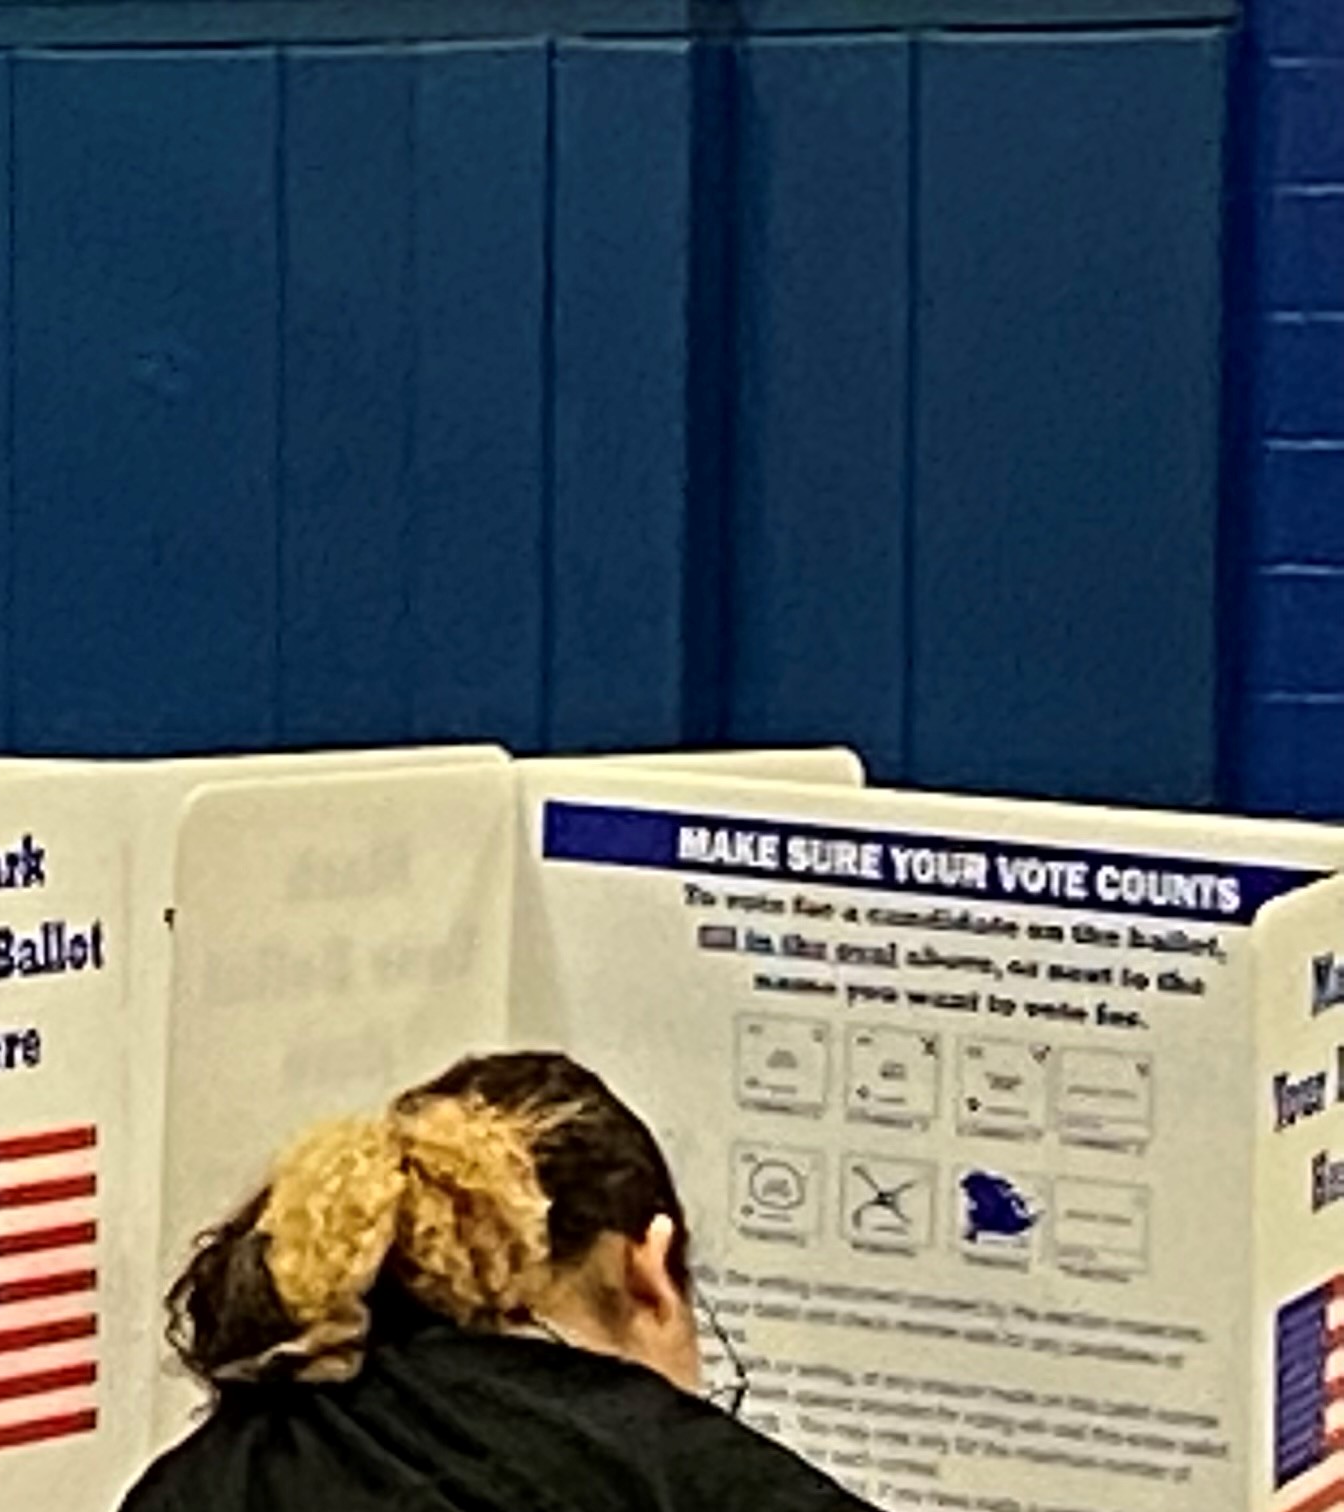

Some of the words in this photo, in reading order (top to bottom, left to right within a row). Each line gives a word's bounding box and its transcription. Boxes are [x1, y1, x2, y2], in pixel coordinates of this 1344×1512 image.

[678, 826, 780, 868] MAKE
[787, 835, 884, 880] SURE
[890, 845, 988, 890] YOUR
[996, 853, 1089, 899] VOTE
[1096, 865, 1241, 914] COUNTS
